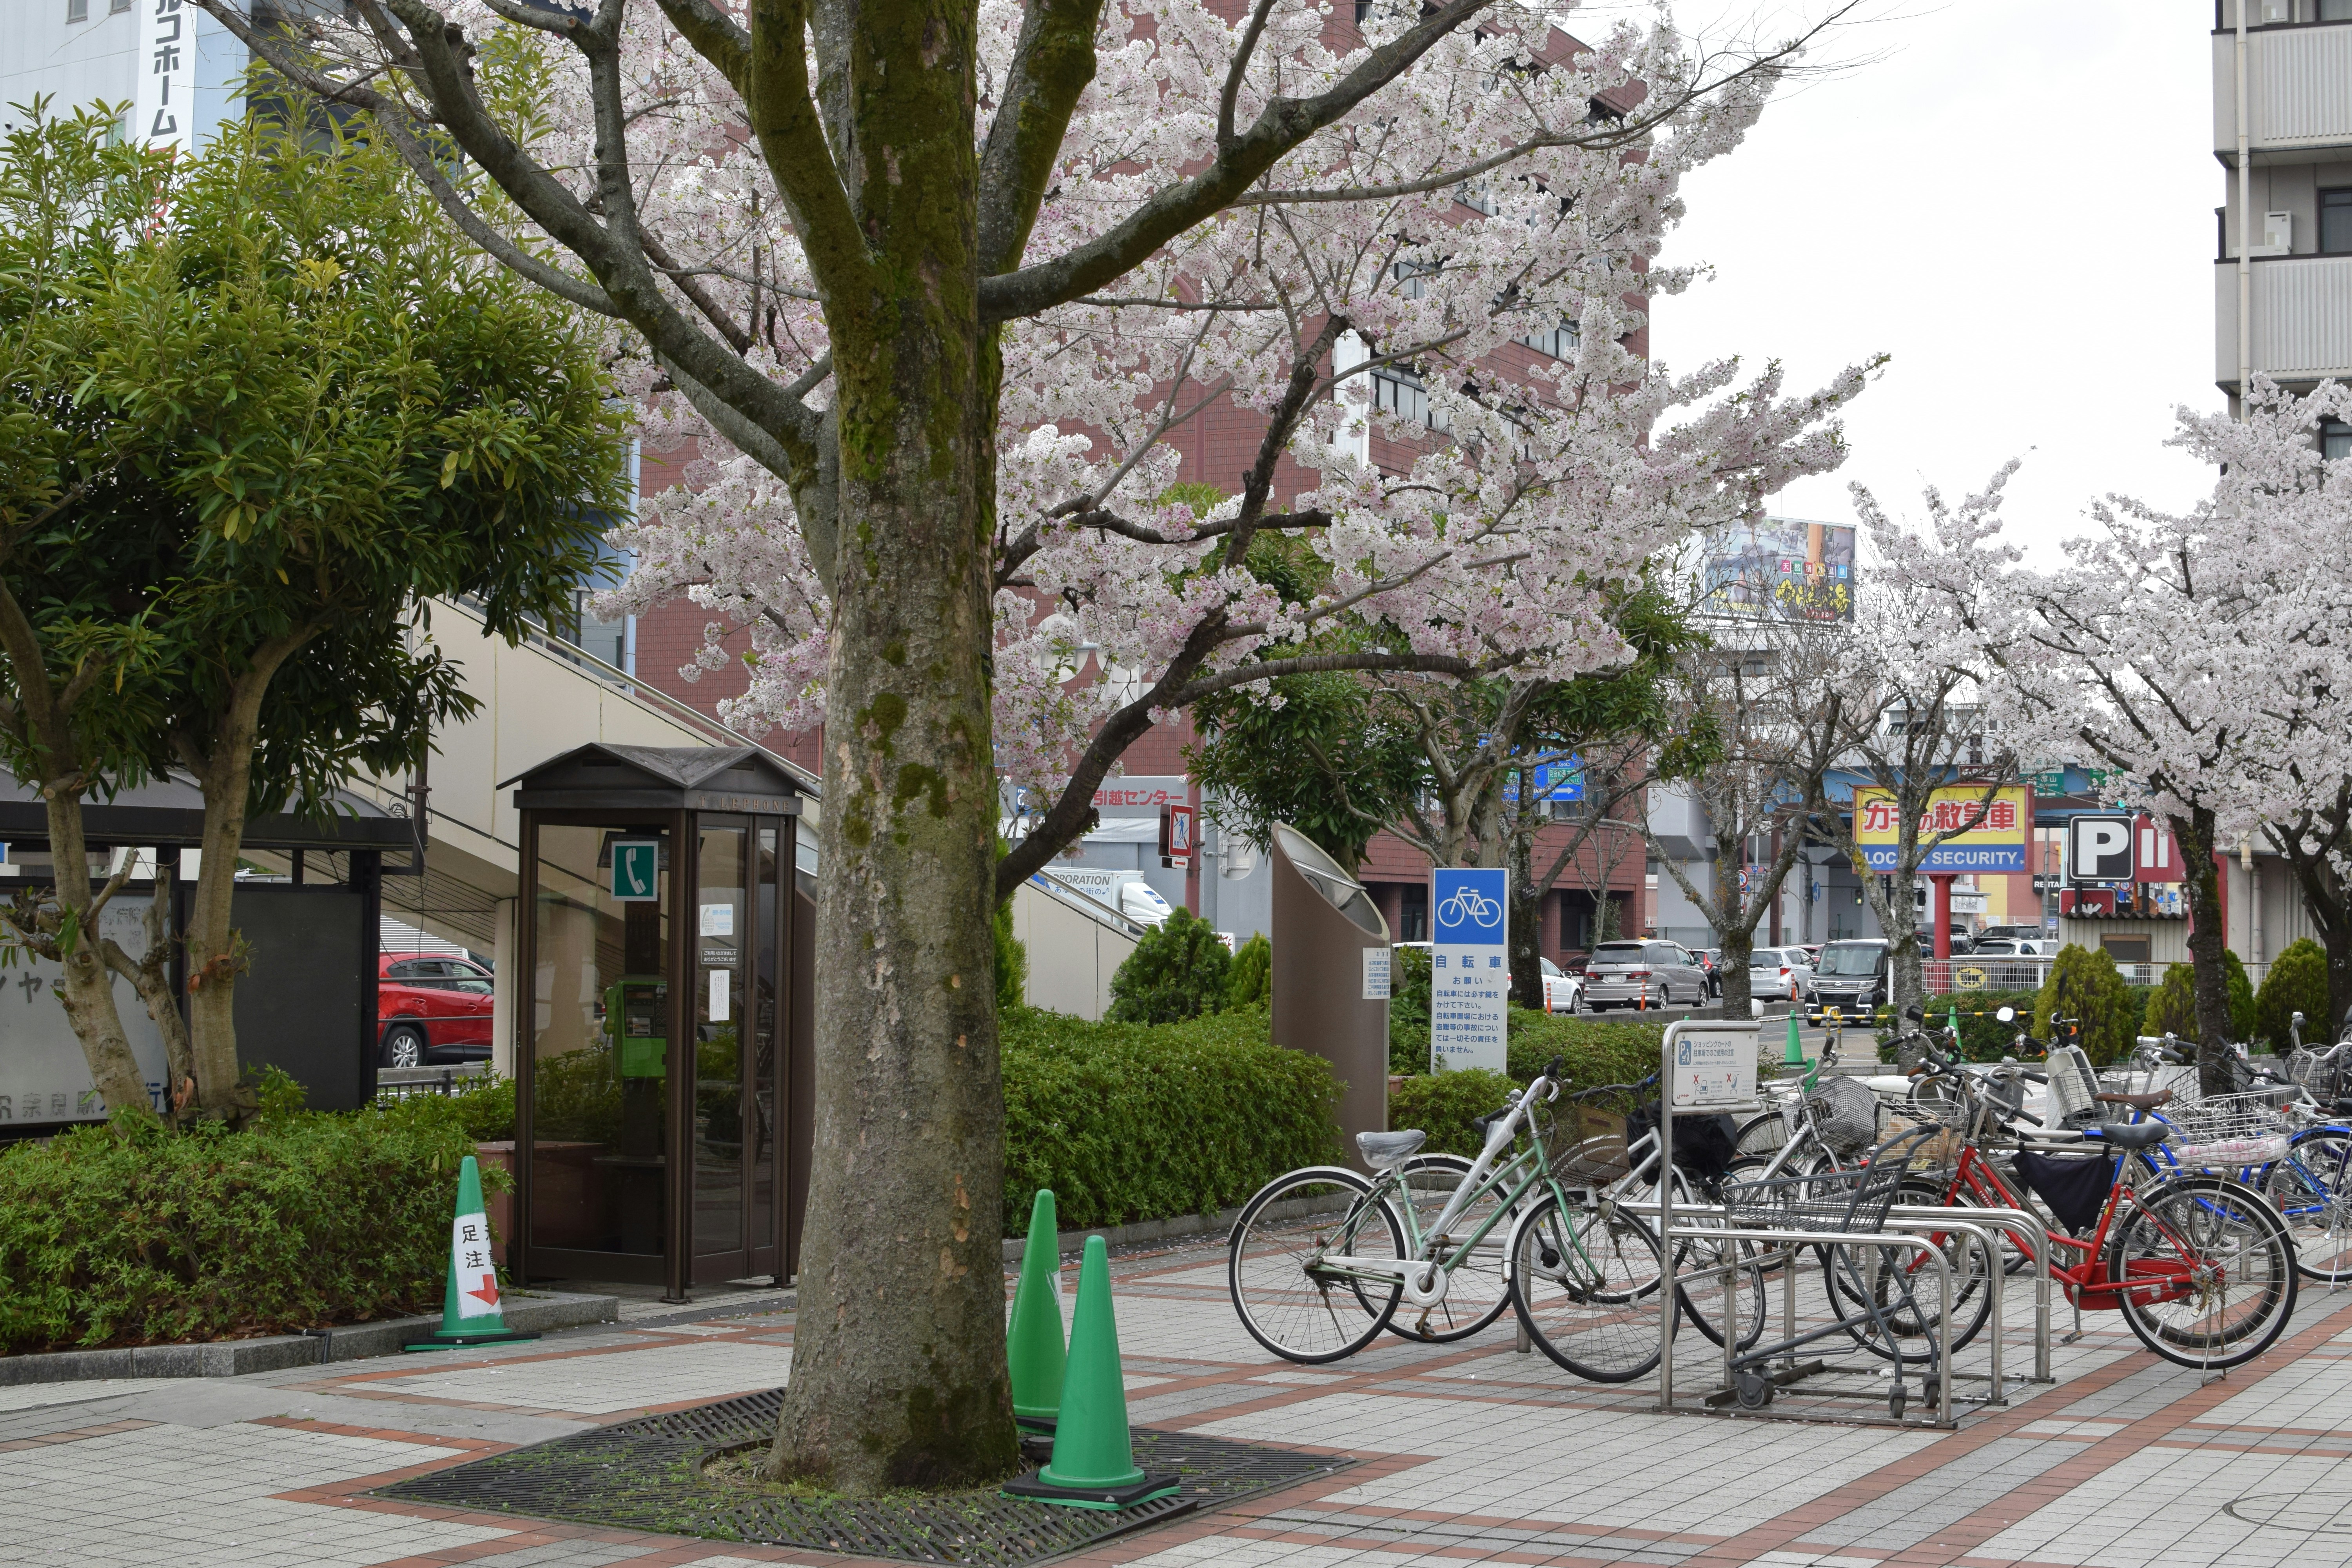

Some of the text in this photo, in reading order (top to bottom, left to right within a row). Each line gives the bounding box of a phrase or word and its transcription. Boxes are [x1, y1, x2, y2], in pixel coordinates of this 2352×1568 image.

[1094, 789, 1183, 806] 引越センター
[2078, 822, 2129, 875] P
[1932, 851, 2018, 864] SECURITY
[1436, 955, 1501, 968] 自転車
[1453, 976, 1482, 985] お願い
[1437, 990, 1499, 998] 自転車には必ず鍵を
[1436, 1012, 1499, 1020] 自転車置場における
[1436, 1023, 1498, 1031] 盗難等の事故につい
[1436, 1034, 1498, 1043] ては一切その責任を
[1436, 1045, 1474, 1054] 負いません。
